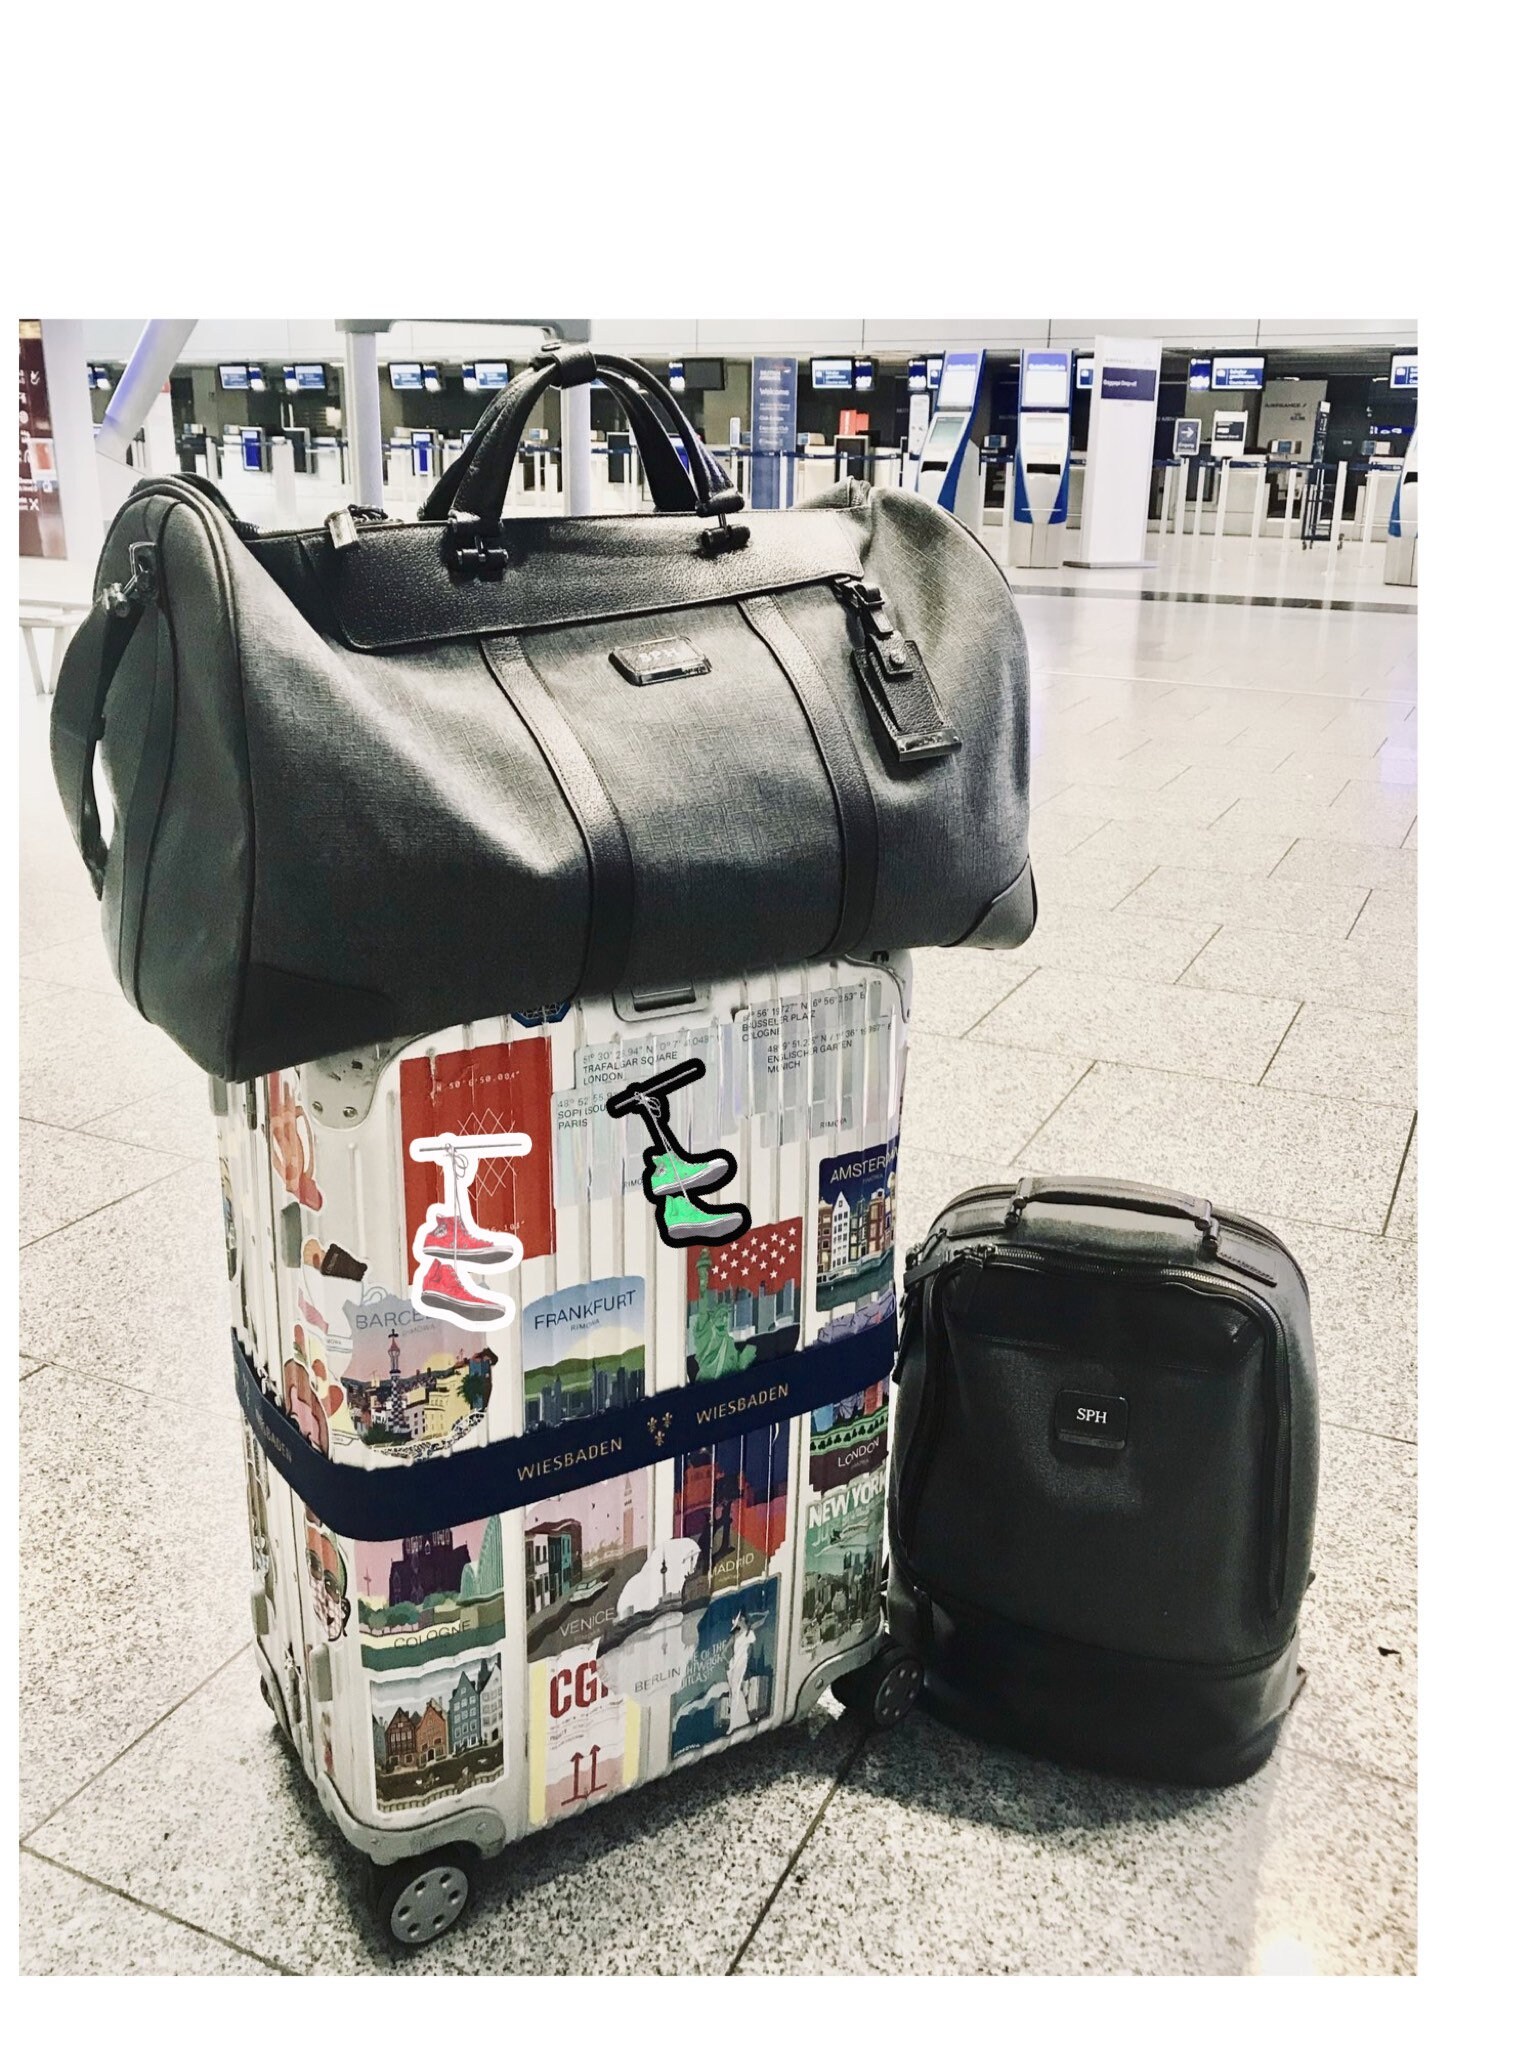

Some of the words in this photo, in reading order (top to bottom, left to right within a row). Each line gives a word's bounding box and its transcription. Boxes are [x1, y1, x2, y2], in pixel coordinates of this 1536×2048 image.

[791, 1010, 816, 1022] PLAZ
[742, 1026, 780, 1042] CLOGN
[767, 1050, 817, 1064] ENLISCHR
[819, 1040, 853, 1054] GAREN
[583, 1073, 624, 1087] LONDON
[558, 1118, 588, 1130] PARIS
[355, 1309, 433, 1330] BARCE
[534, 1289, 637, 1330] FRANKFURT
[570, 1318, 600, 1331] RIMOWA
[695, 1382, 790, 1425] WIESBADEN
[1076, 1407, 1108, 1424] SPH
[516, 1436, 624, 1482] WIESBADEN
[837, 1436, 880, 1468] LONDON
[808, 1489, 850, 1530] NEW
[393, 1618, 471, 1649] COLOGNE
[559, 1607, 616, 1638] VENICE
[634, 1666, 681, 1693] BERLIN
